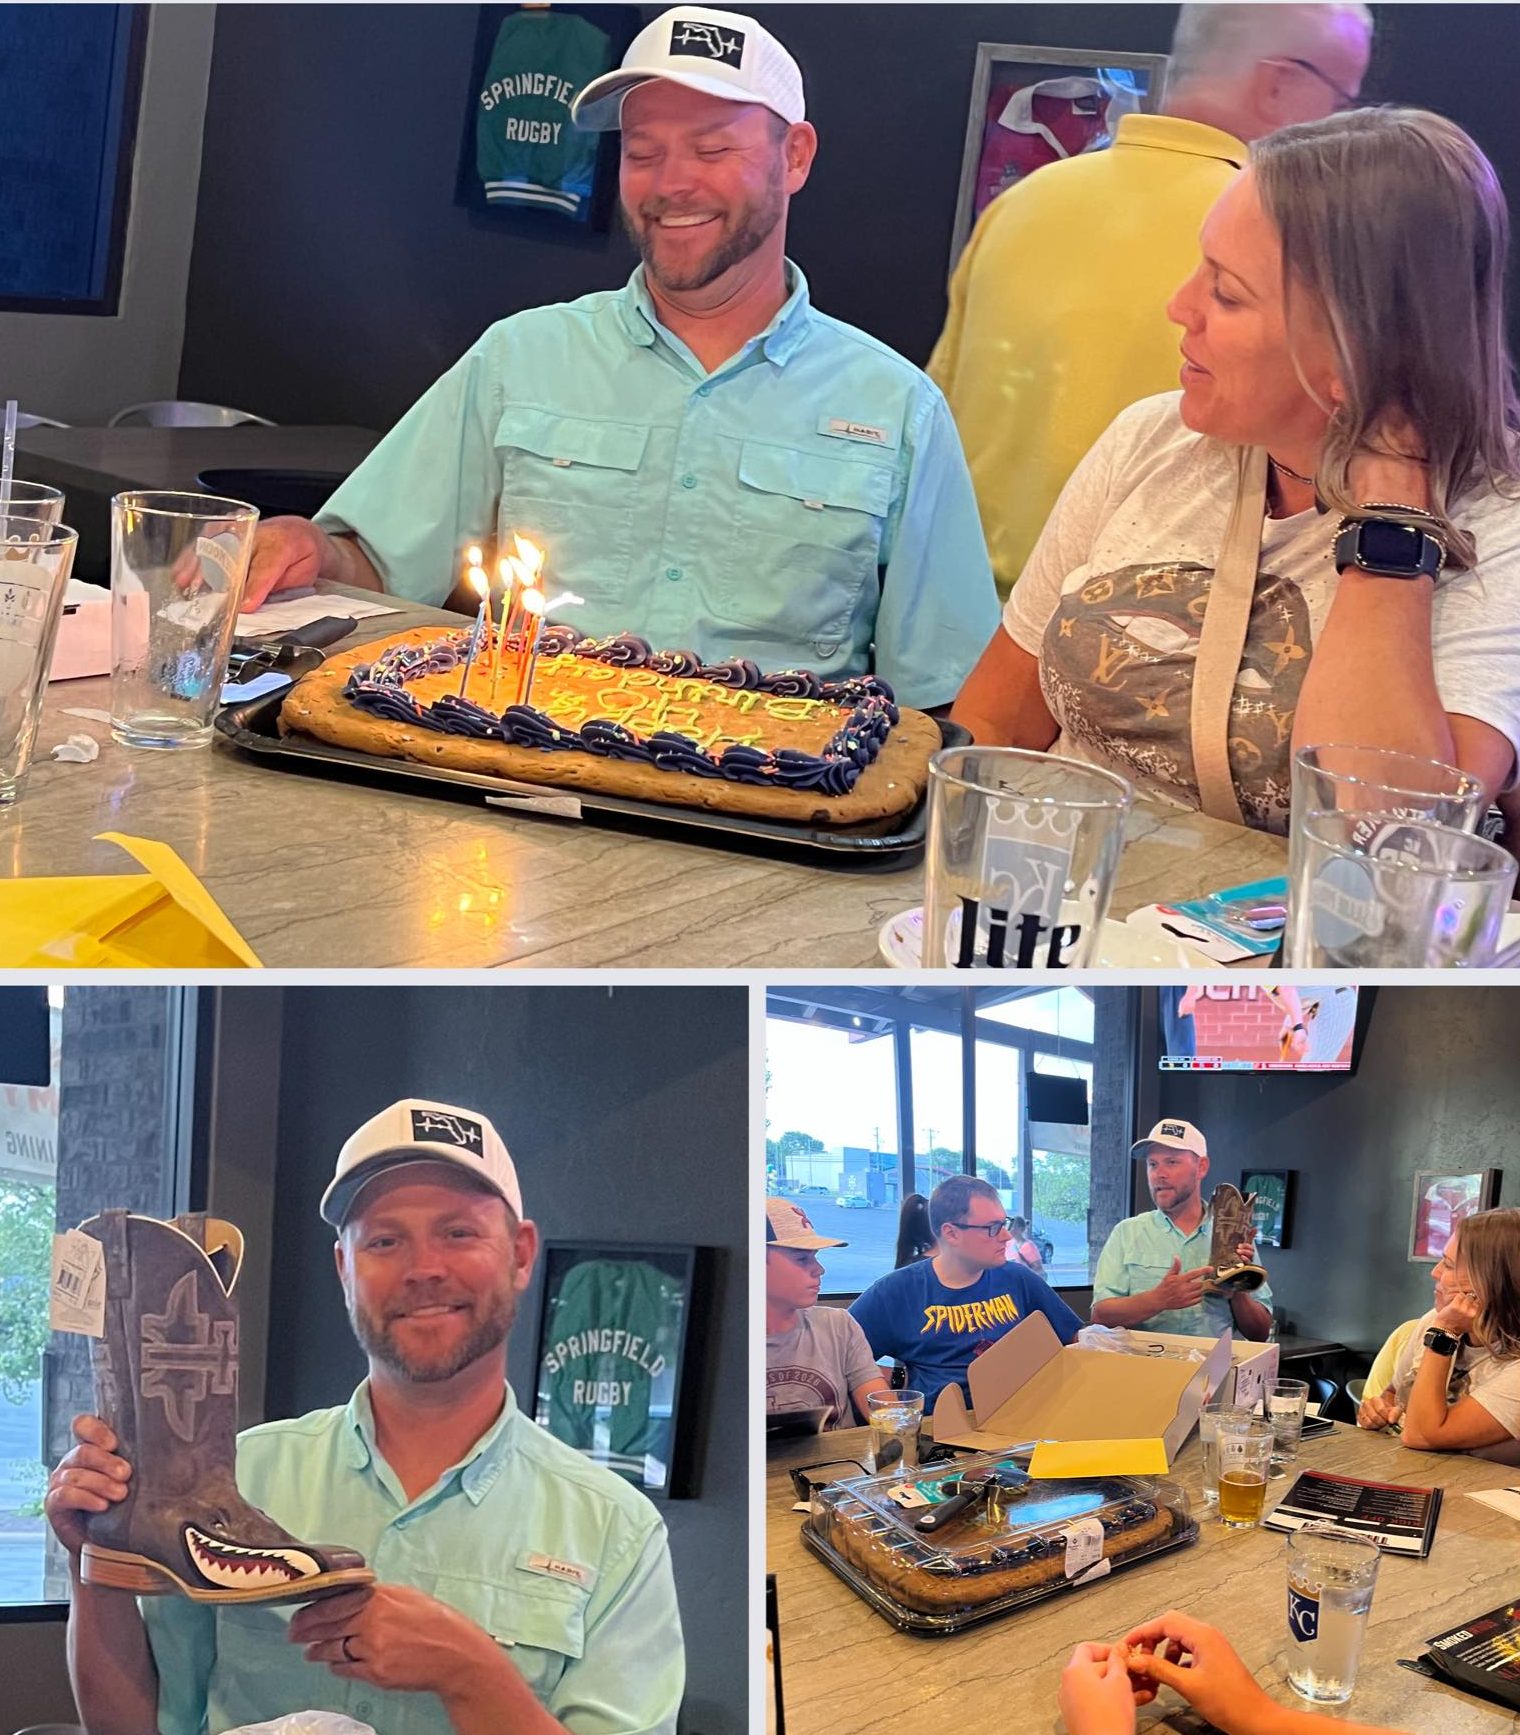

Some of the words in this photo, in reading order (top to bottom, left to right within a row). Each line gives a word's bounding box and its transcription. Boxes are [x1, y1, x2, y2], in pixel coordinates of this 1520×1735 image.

[480, 72, 575, 111] SPRINGFIE
[506, 117, 562, 145] RUGBY
[953, 894, 1082, 968] lite
[920, 1293, 1021, 1335] SPIDER-MAN
[545, 1328, 666, 1378] SPRINGFIELD
[573, 1379, 632, 1406] RUGBY
[1287, 1591, 1316, 1637] KC
[1432, 1629, 1474, 1651] SMOKED
